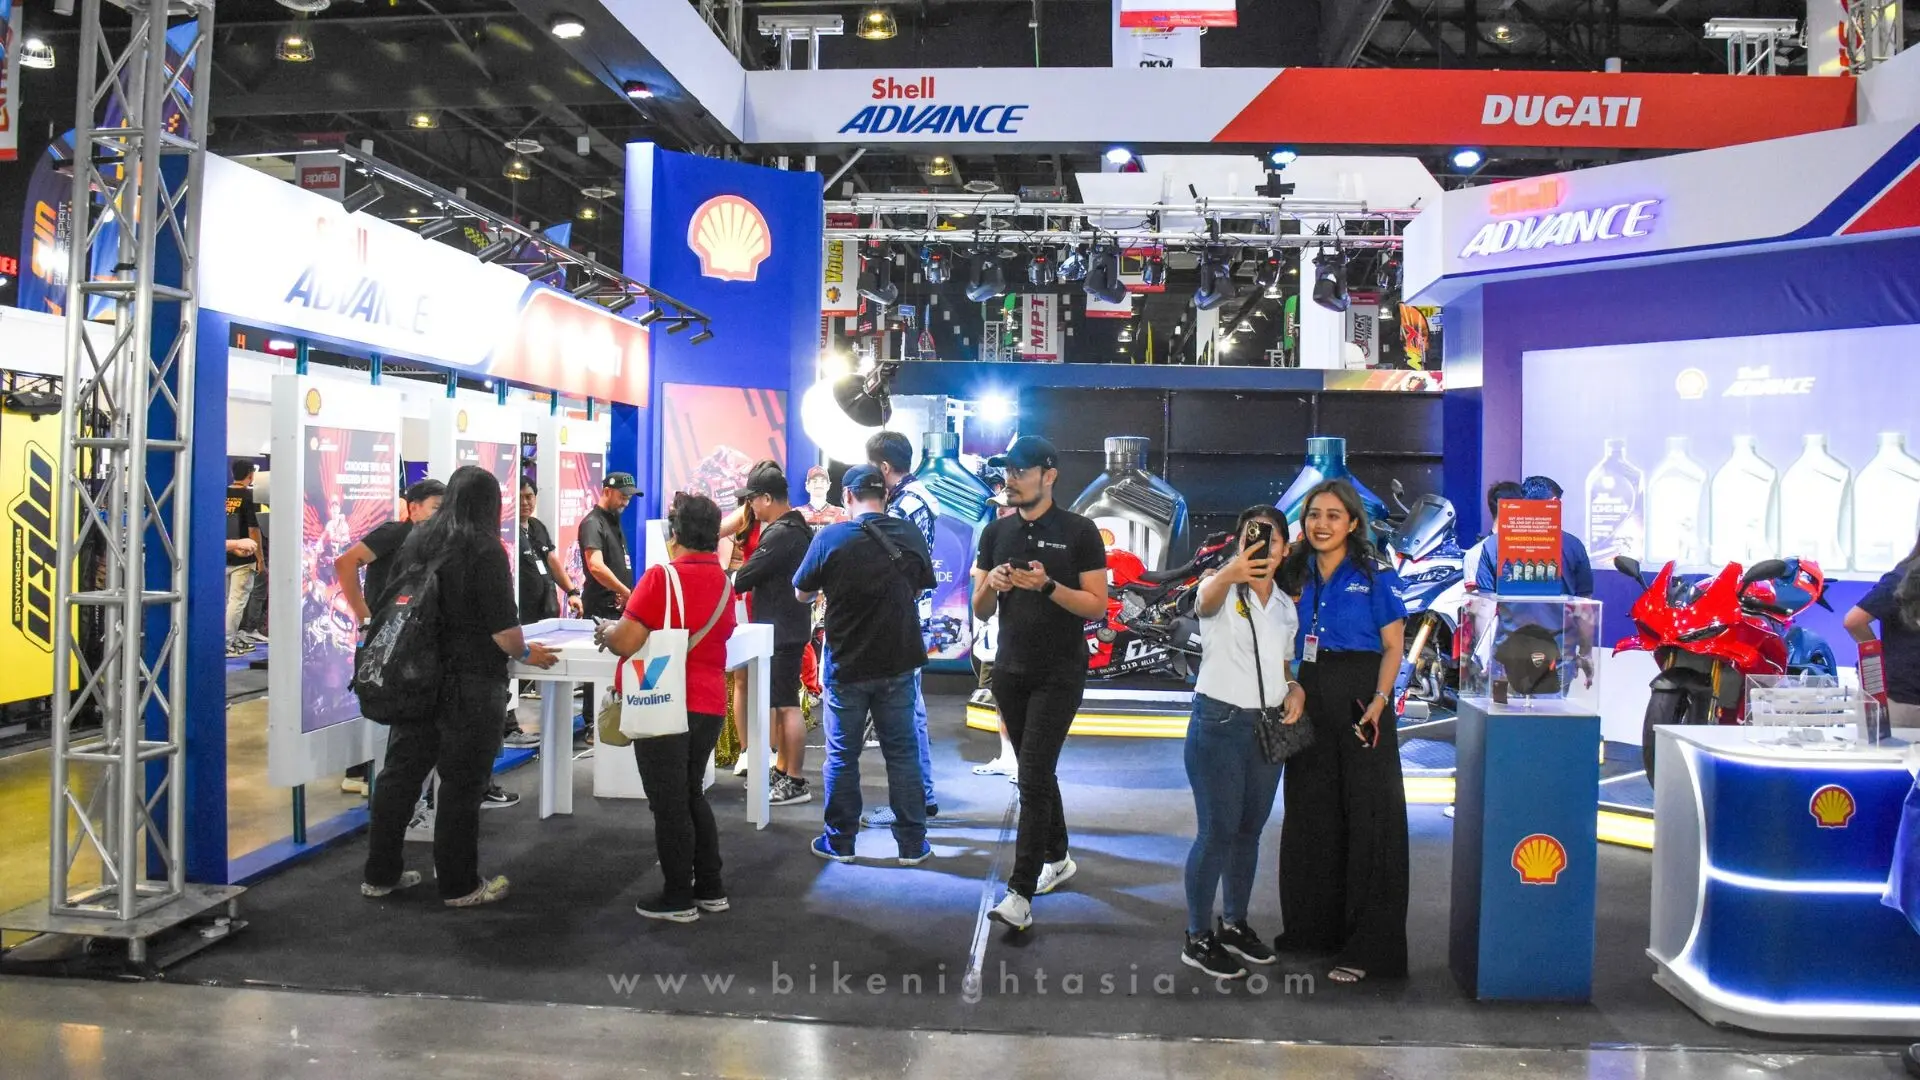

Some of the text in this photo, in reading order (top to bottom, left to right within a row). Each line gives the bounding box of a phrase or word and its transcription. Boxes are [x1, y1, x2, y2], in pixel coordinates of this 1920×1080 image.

[871, 76, 935, 100] Shell
[837, 104, 1029, 134] ADVANCE
[1481, 94, 1642, 128] DUCATI
[304, 170, 337, 185] aprilia
[1489, 179, 1559, 216] Shell
[1457, 198, 1662, 259] ADVANCE
[1030, 294, 1045, 349] MPT
[1721, 377, 1816, 397] ADVANCE
[13, 528, 22, 623] PERFORMANCE
